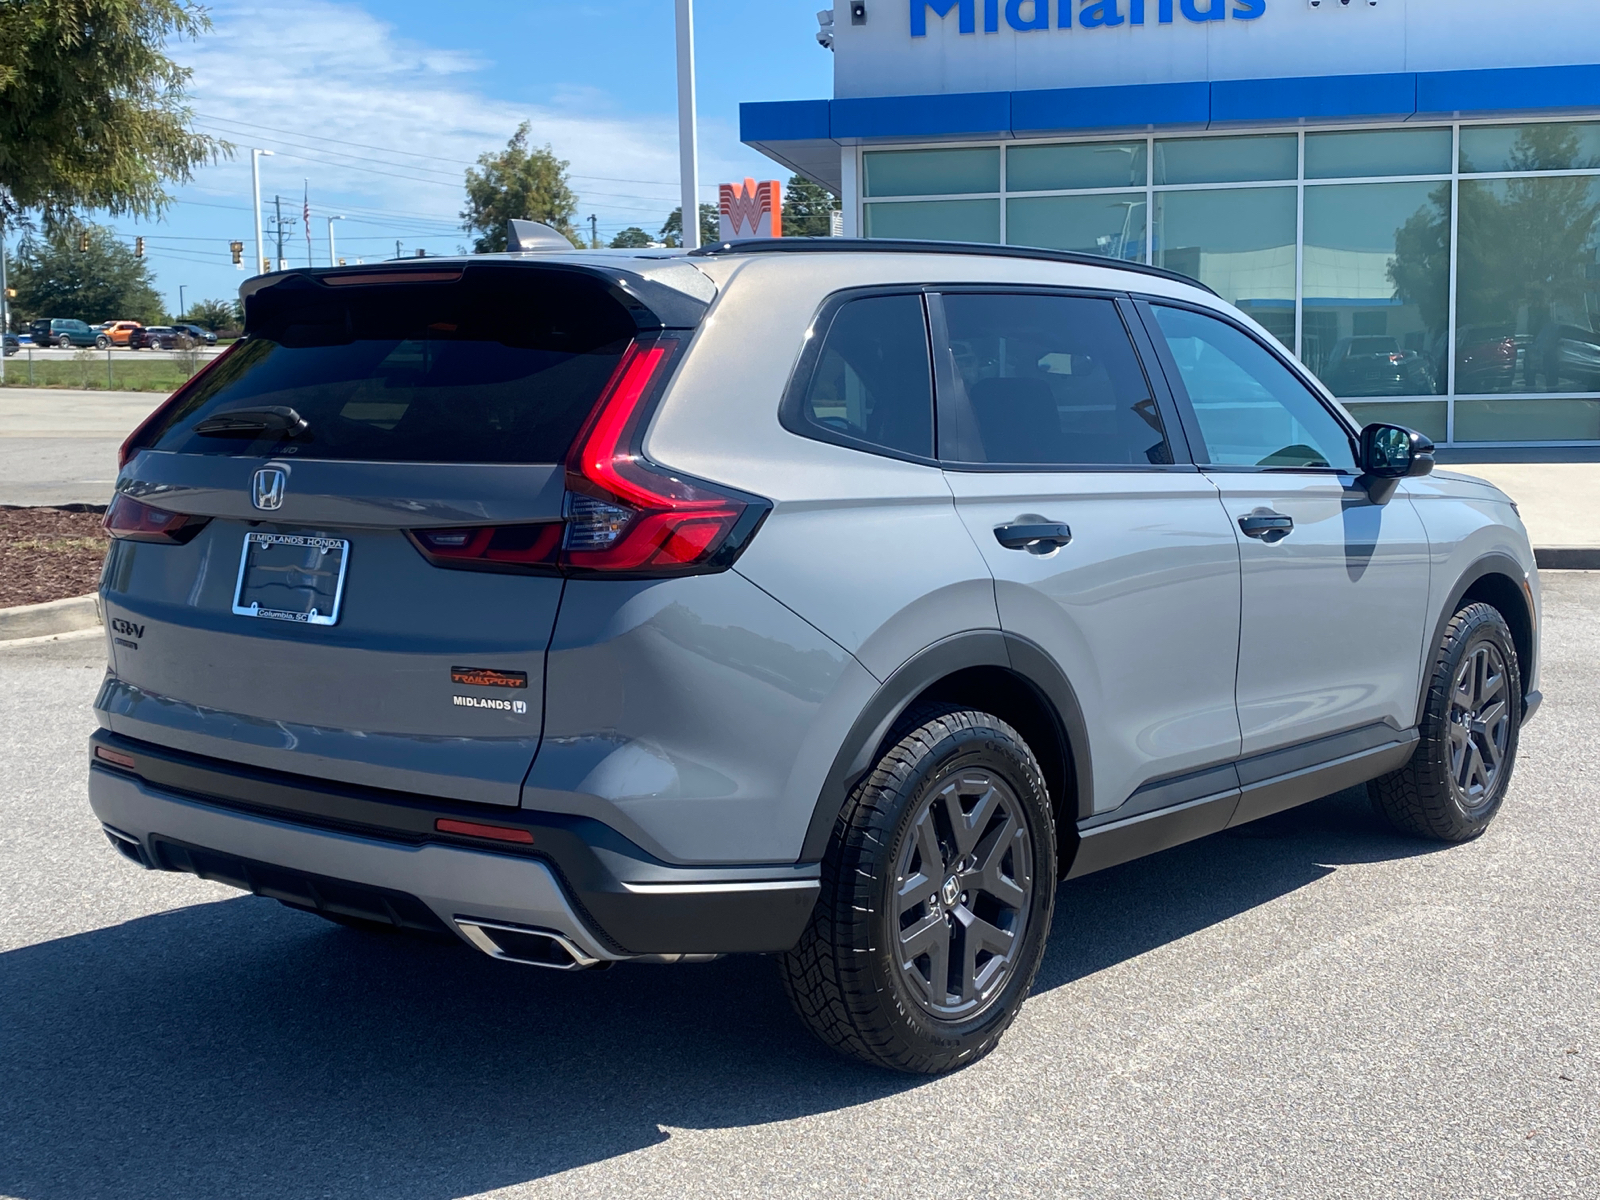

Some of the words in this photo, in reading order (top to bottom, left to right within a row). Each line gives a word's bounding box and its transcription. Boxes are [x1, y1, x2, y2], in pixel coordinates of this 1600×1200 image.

[256, 534, 304, 545] MIDLANDS
[307, 539, 342, 548] HONDA
[258, 609, 295, 620] Columbia,
[295, 612, 307, 622] SC
[452, 673, 524, 688] TRAILSPORT
[453, 695, 512, 711] MIDLANDS
